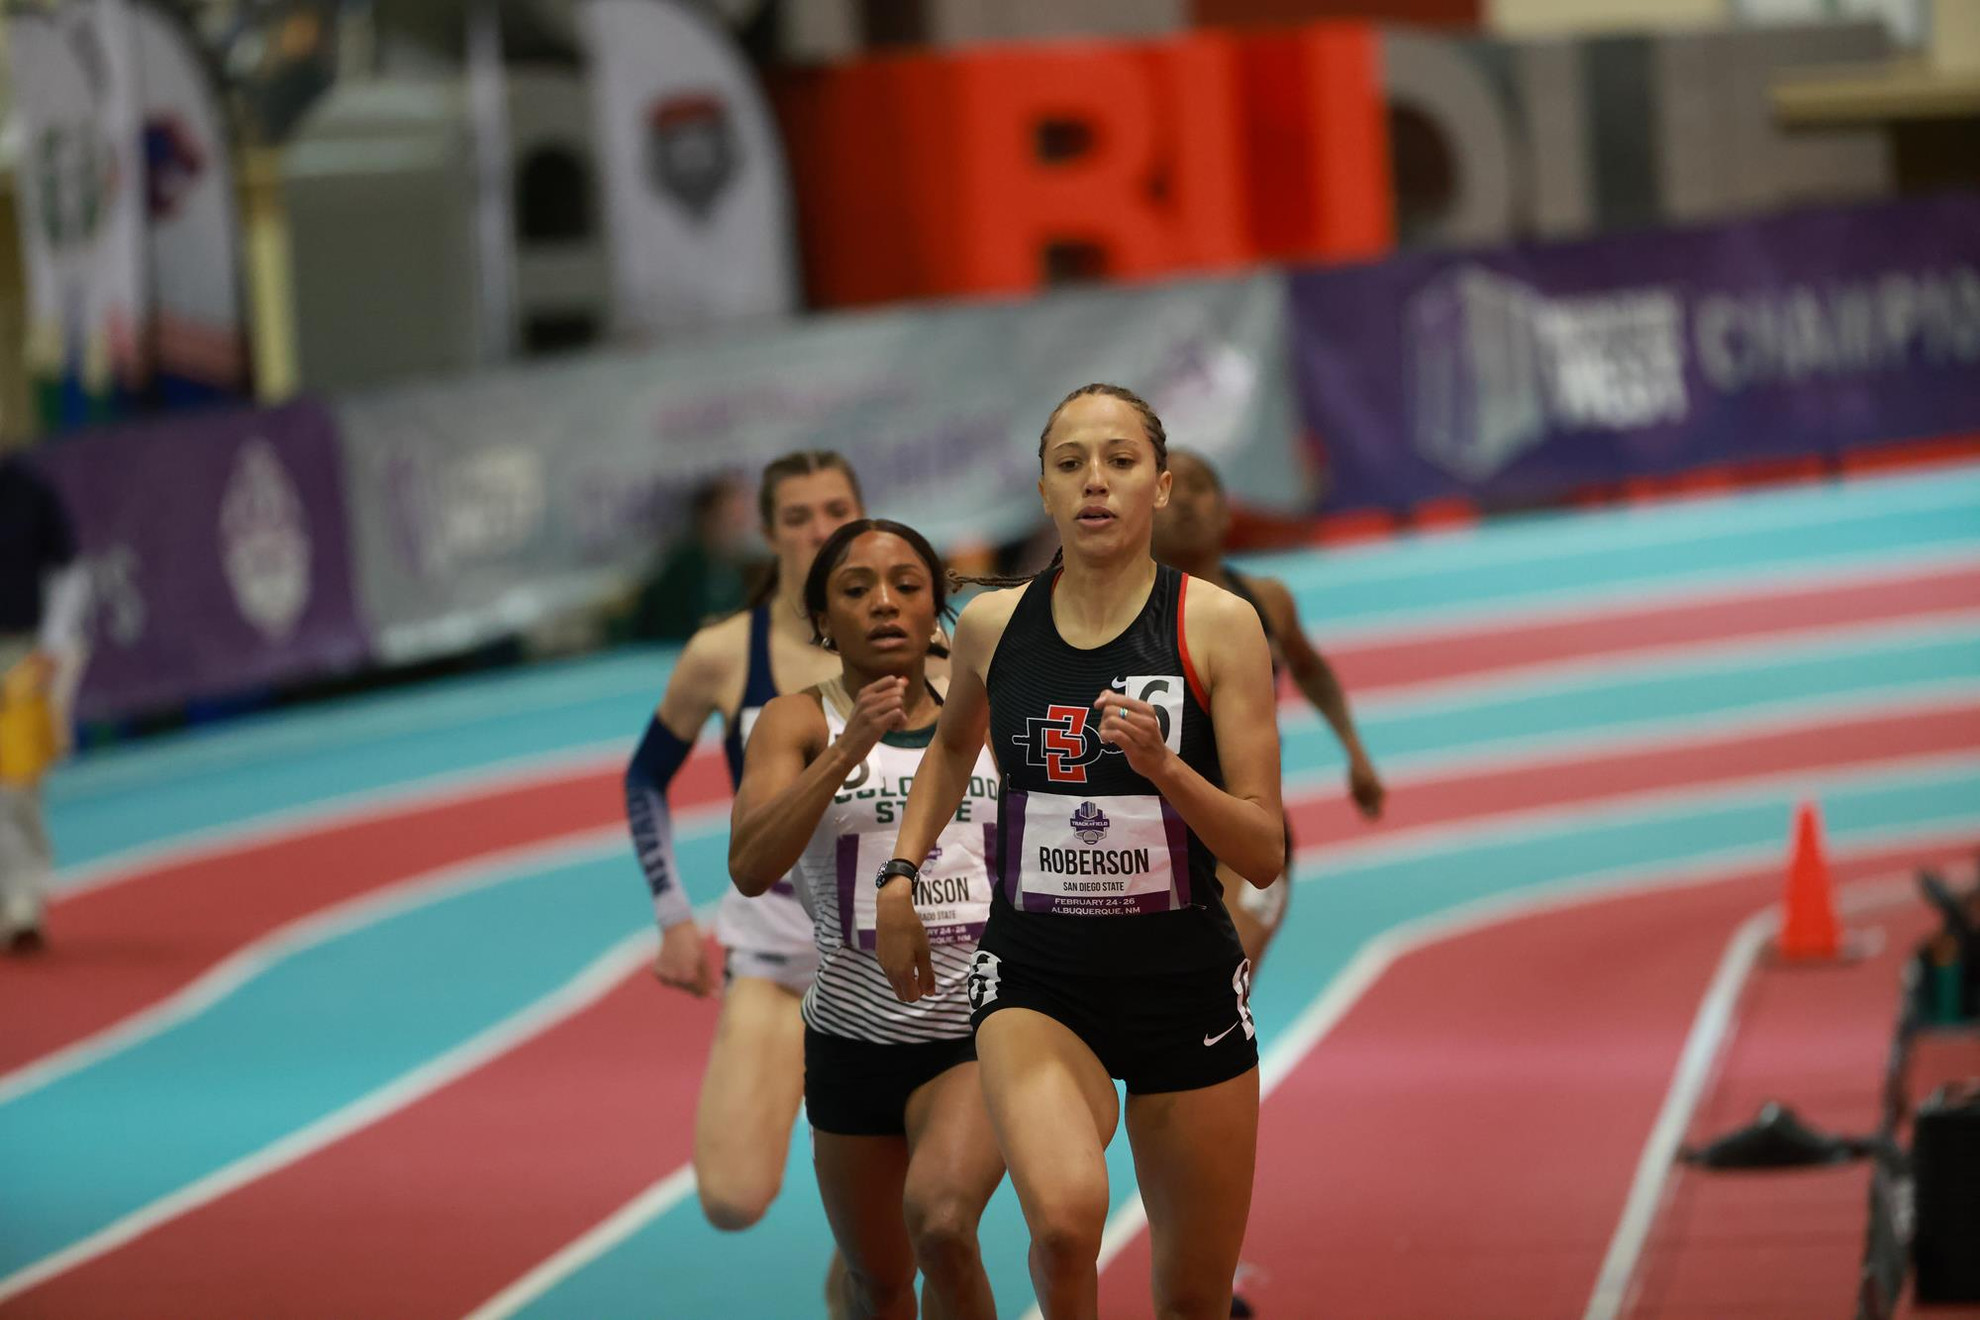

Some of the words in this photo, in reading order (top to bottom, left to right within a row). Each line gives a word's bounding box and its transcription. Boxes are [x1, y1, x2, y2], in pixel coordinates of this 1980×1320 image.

[1139, 679, 1170, 744] 6
[1039, 846, 1149, 875] ROBERSON
[1063, 881, 1078, 892] SAN
[1079, 882, 1101, 892] DIEGO
[1102, 881, 1124, 892] STATE
[1054, 898, 1104, 906] FEBRUARY
[1051, 906, 1124, 915] ALBUQUERQUE,
[1125, 906, 1141, 914] NM
